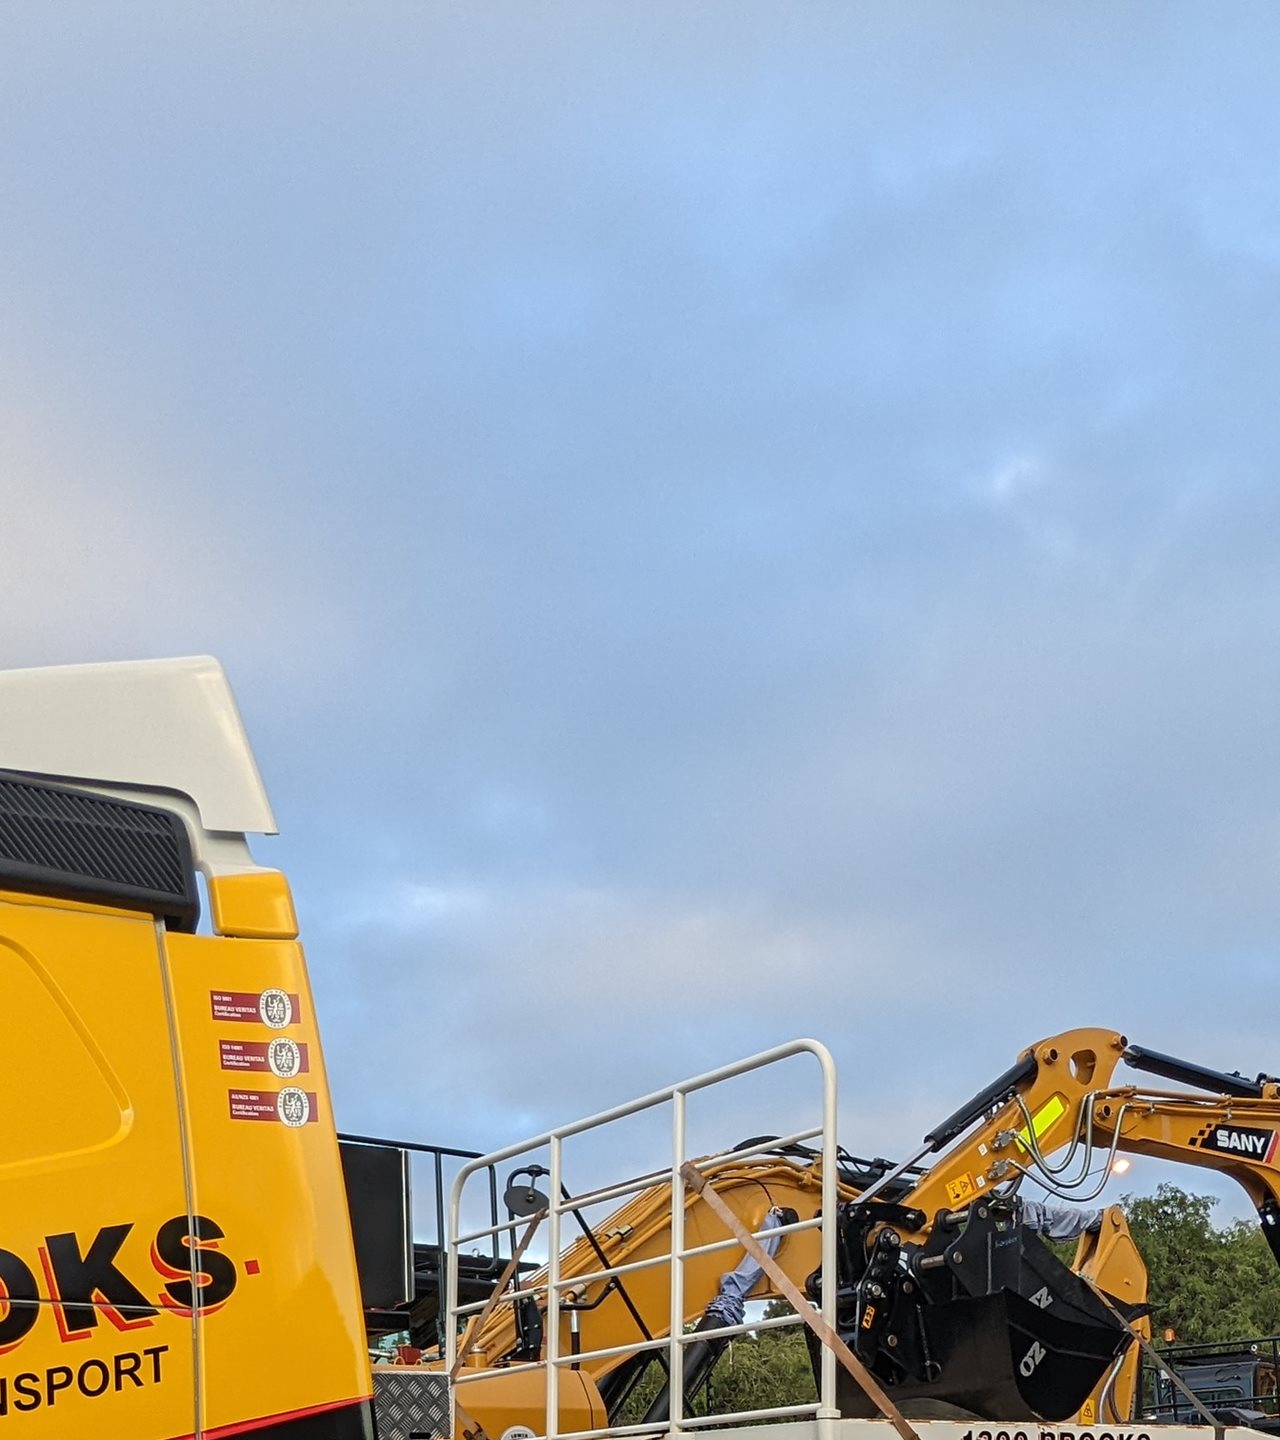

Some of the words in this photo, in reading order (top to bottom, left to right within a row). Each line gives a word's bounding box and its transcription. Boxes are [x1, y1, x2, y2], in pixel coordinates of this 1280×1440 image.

[235, 1006, 257, 1014] VERITAS
[1216, 1129, 1266, 1154] SANY
[1019, 1340, 1047, 1377] OZ
